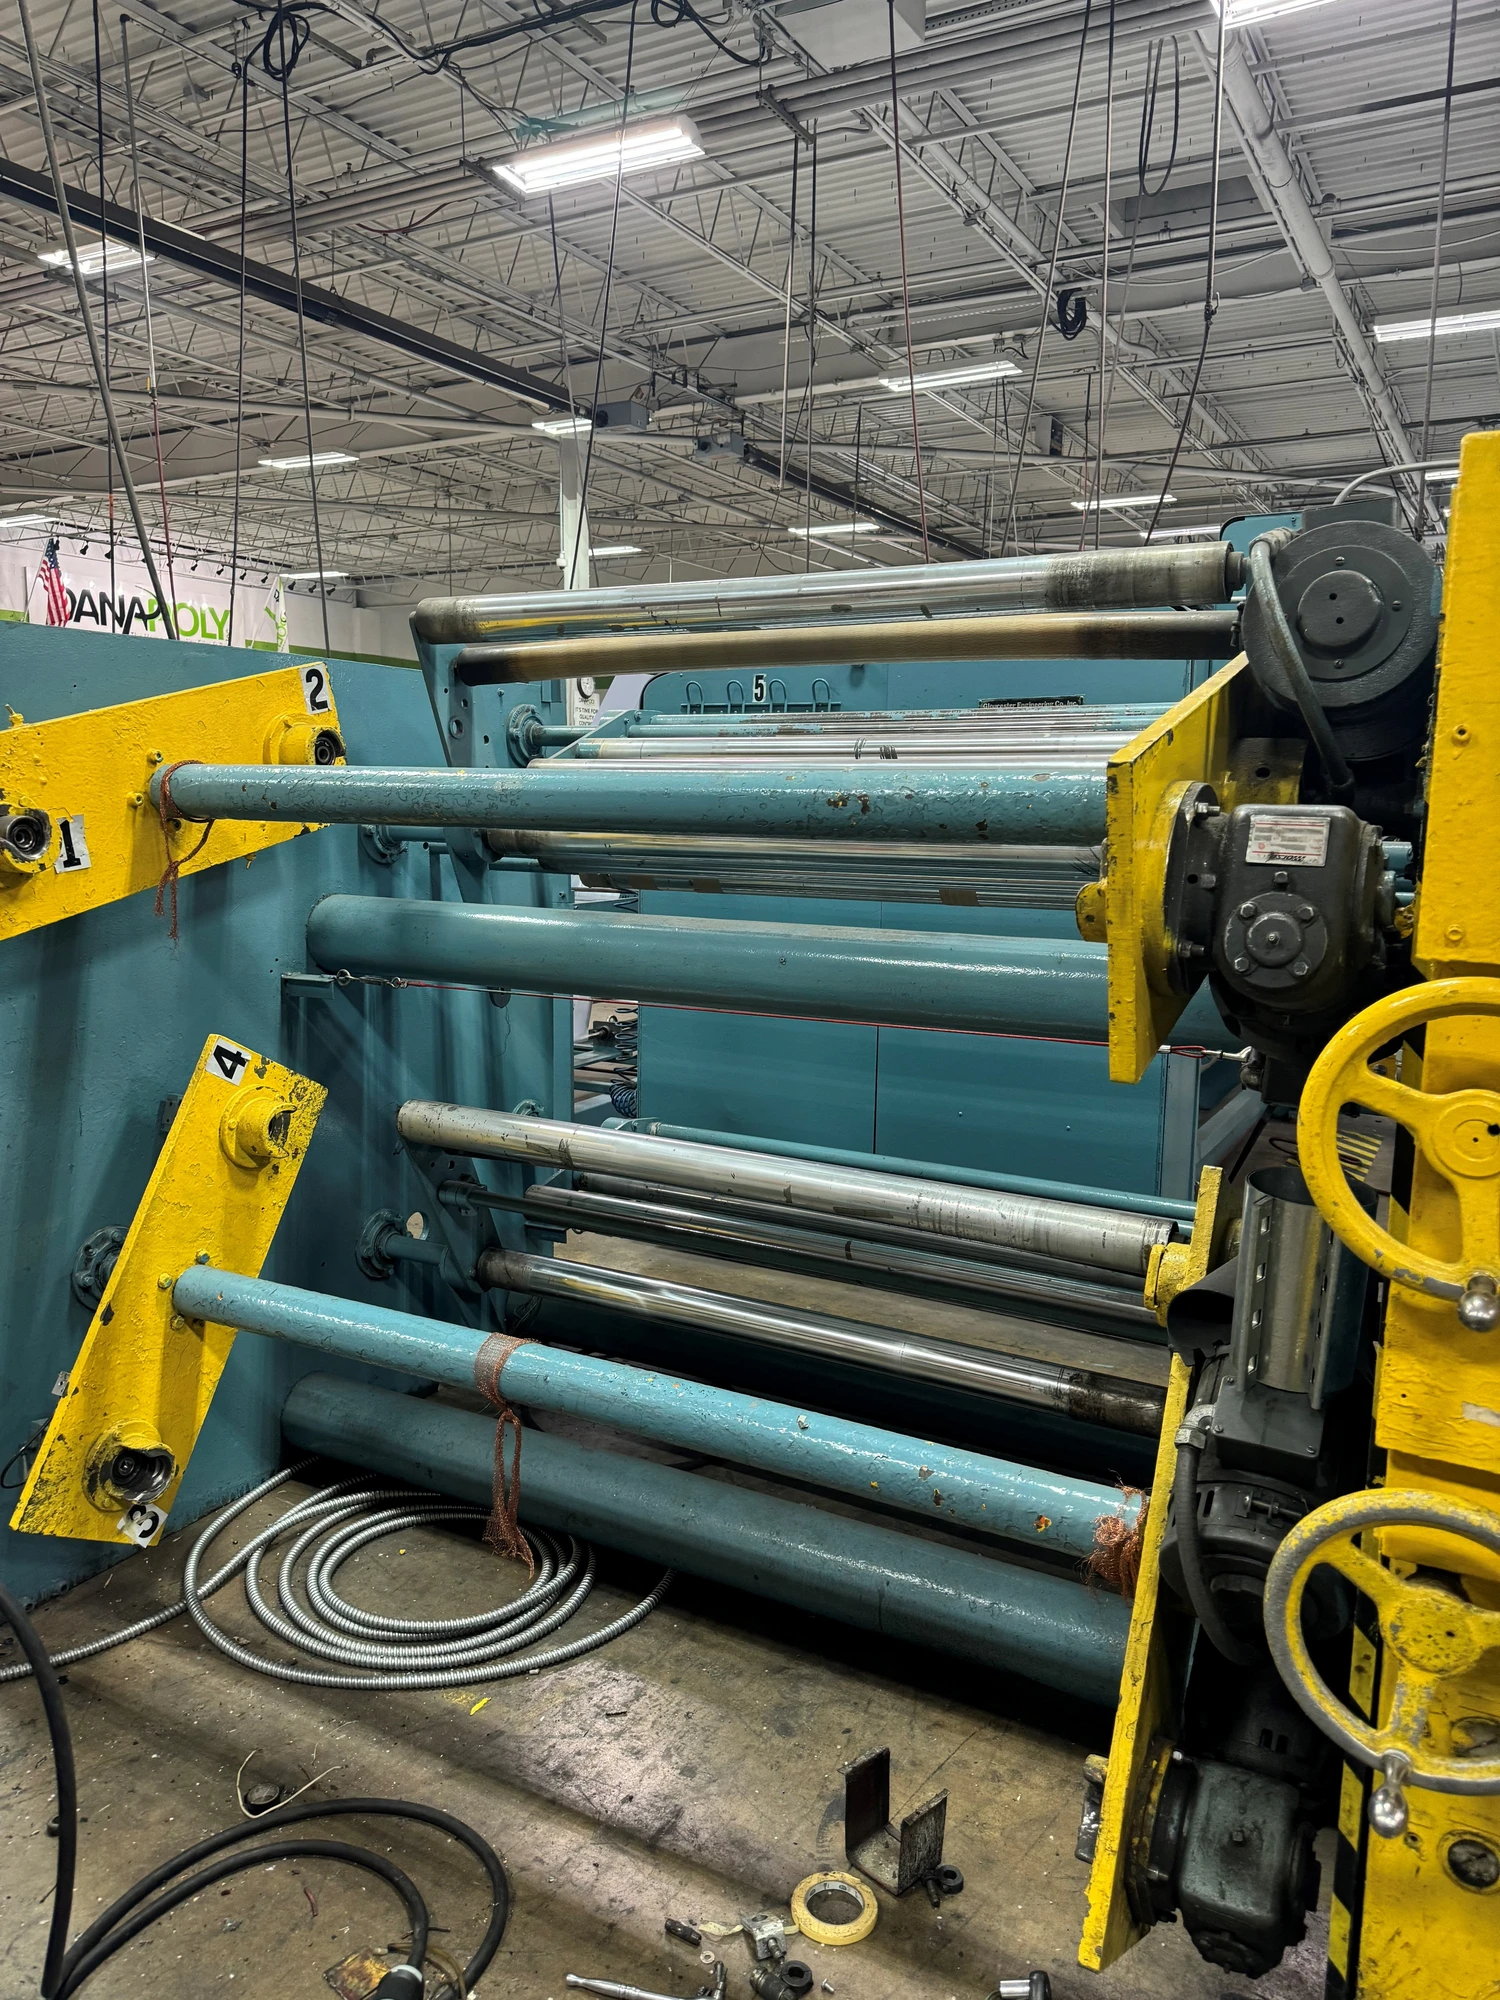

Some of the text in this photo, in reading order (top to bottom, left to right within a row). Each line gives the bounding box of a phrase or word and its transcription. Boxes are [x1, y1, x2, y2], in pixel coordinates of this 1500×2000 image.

[305, 668, 328, 711] 2
[754, 675, 764, 702] 5
[59, 820, 82, 868] 1
[213, 1044, 247, 1080] 4
[128, 1504, 160, 1539] 3
